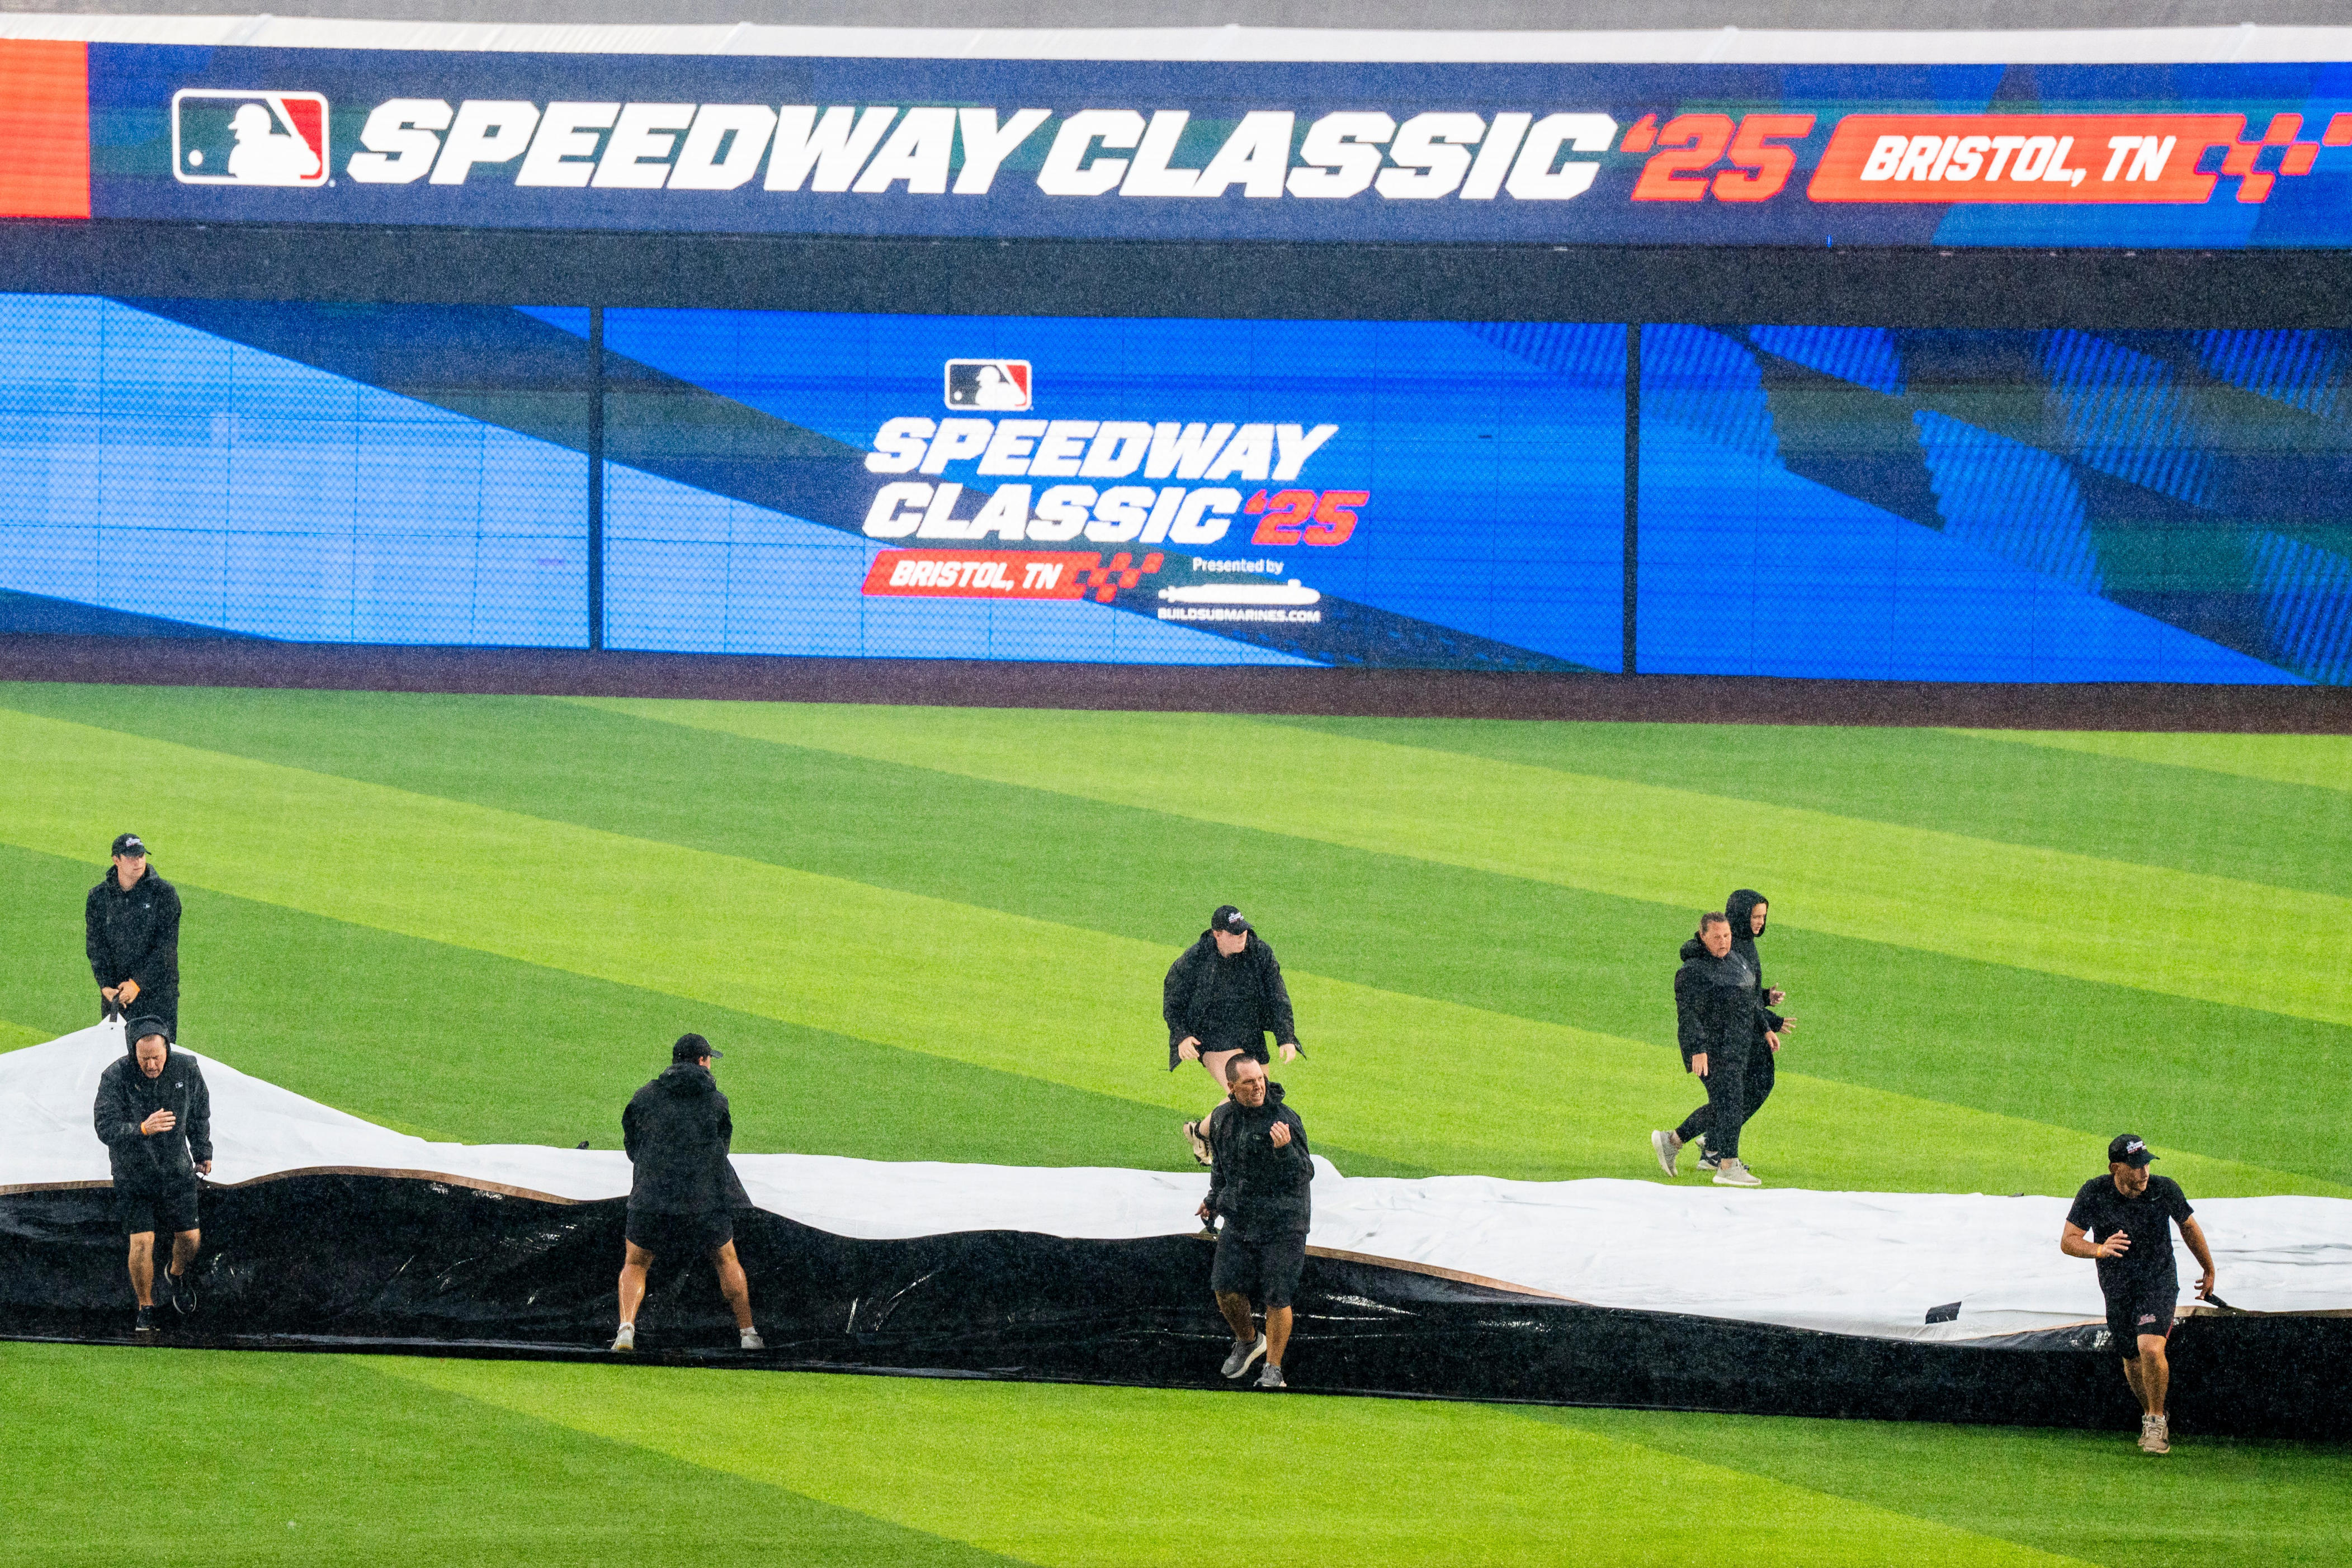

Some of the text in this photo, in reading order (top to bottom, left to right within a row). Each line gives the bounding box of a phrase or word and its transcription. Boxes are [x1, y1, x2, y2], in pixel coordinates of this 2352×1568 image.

[346, 98, 1054, 195] SPEEDWAY
[1036, 109, 1618, 200] CLASSIC
[1860, 135, 2176, 187] BRISTOL, TN
[864, 417, 1339, 481] SPEEDWAY
[862, 482, 1242, 544] CLASSIC
[889, 560, 1064, 591] BRISTOL, TN
[1193, 557, 1284, 575] Presented by
[1157, 608, 1321, 624] BUILDSUBMARINES.COM
